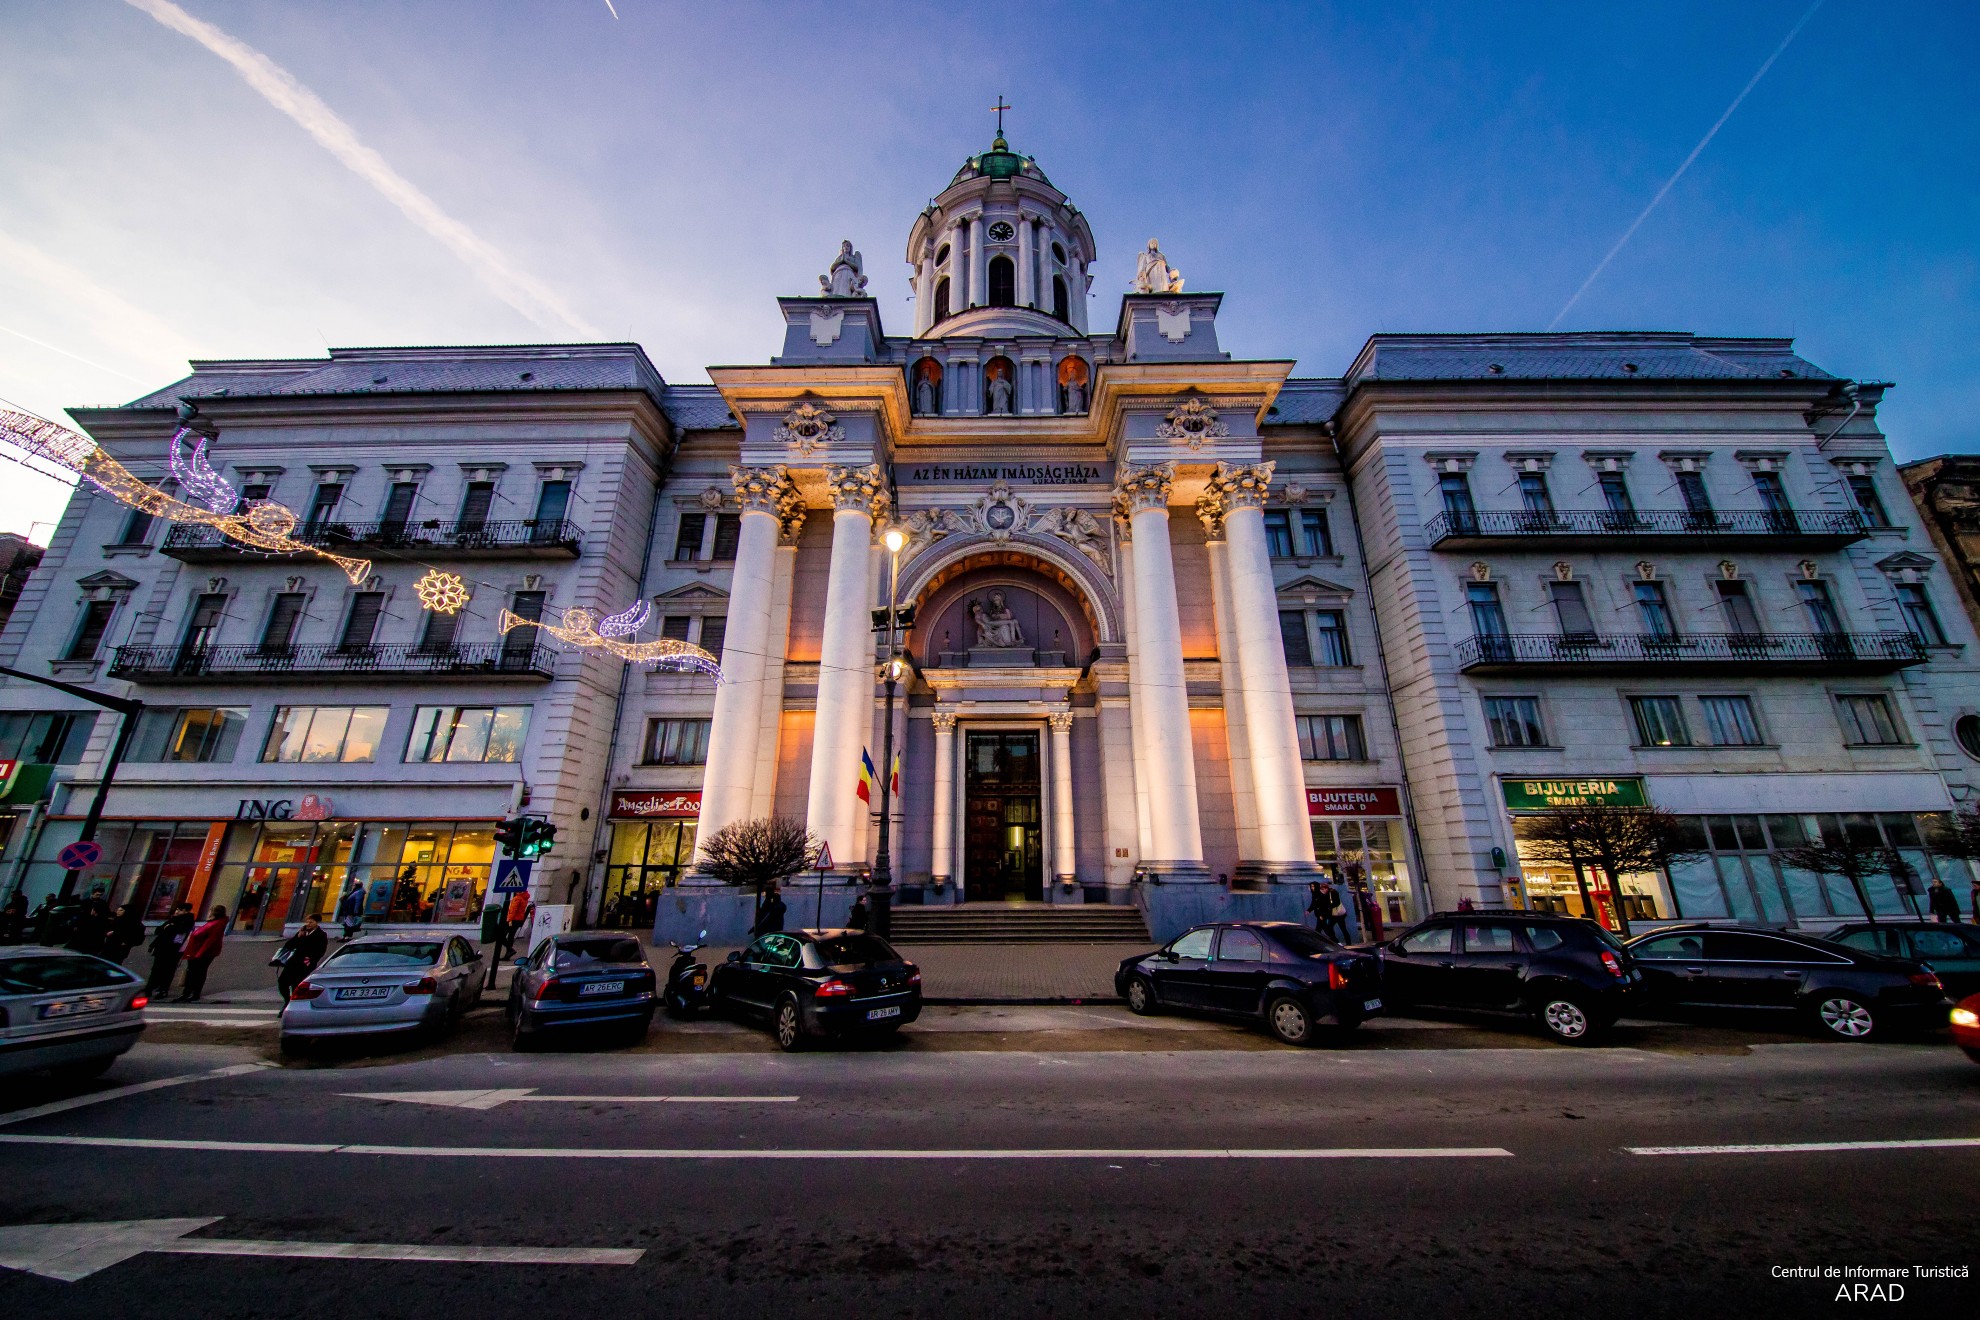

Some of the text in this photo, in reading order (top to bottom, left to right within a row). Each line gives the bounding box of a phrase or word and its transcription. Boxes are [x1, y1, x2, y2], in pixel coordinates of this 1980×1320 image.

[913, 464, 1100, 480] AZ ÉN HÁZAM IMÁDSÁG HÁZA
[1524, 781, 1620, 796] BIJUTERIA
[1309, 793, 1379, 803] BIJUTERIA
[236, 799, 293, 820] ING
[617, 796, 670, 814] Angeli's
[1324, 803, 1355, 811] SMARA
[204, 838, 220, 872] ING Bank
[446, 866, 460, 875] NG
[342, 988, 387, 998] AR 33 AIR
[584, 984, 596, 992] AR
